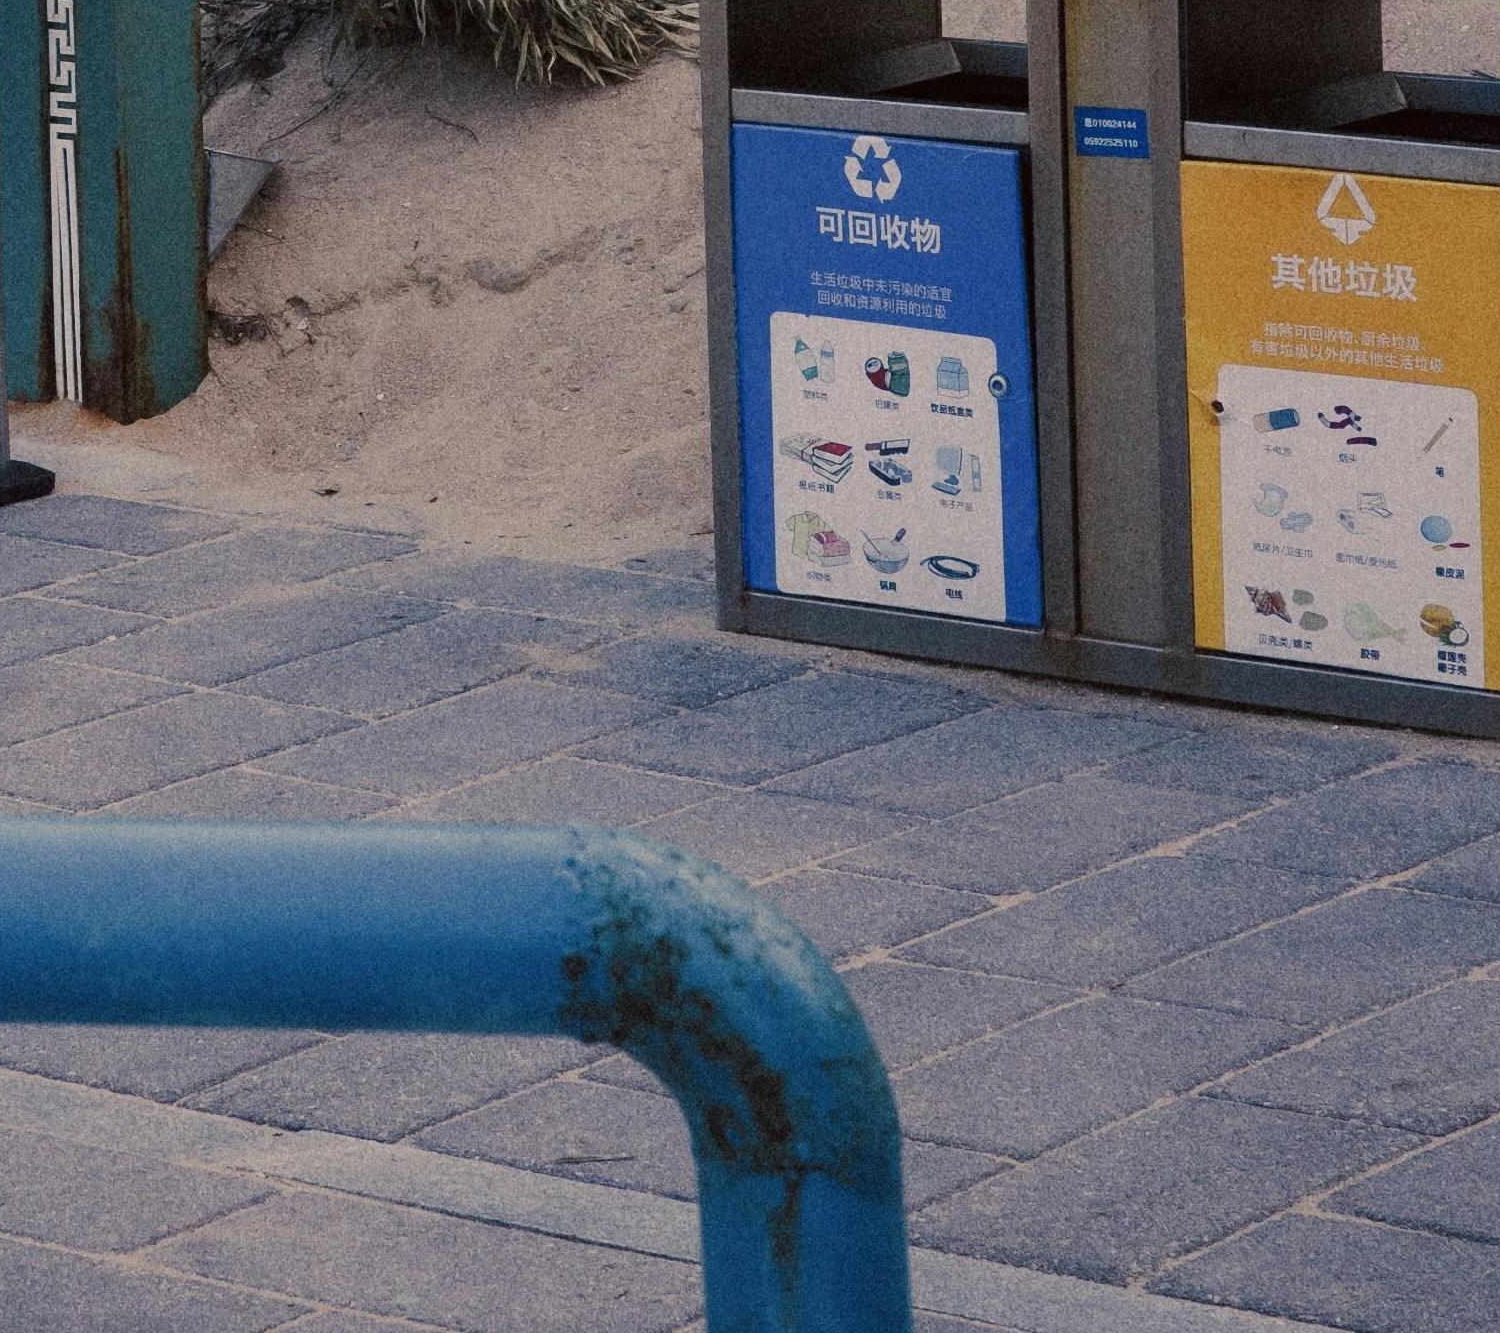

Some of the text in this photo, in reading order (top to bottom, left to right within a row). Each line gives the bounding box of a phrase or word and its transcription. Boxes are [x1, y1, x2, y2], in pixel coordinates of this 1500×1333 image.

[815, 206, 941, 255] 可回收物
[811, 271, 952, 302] 生活垃圾中未污染的适宜
[1271, 253, 1419, 303] 其他垃圾
[817, 290, 947, 320] 回收和资源利用的垃圾
[1250, 339, 1444, 374] 有害垃圾以外的其他生活垃圾
[930, 402, 974, 419] 饮品纸盒类
[939, 499, 973, 512] 电子产品
[1252, 541, 1313, 559] 纸尿片/卫生巾
[945, 588, 963, 600] 电线
[1360, 647, 1381, 661] 胶带
